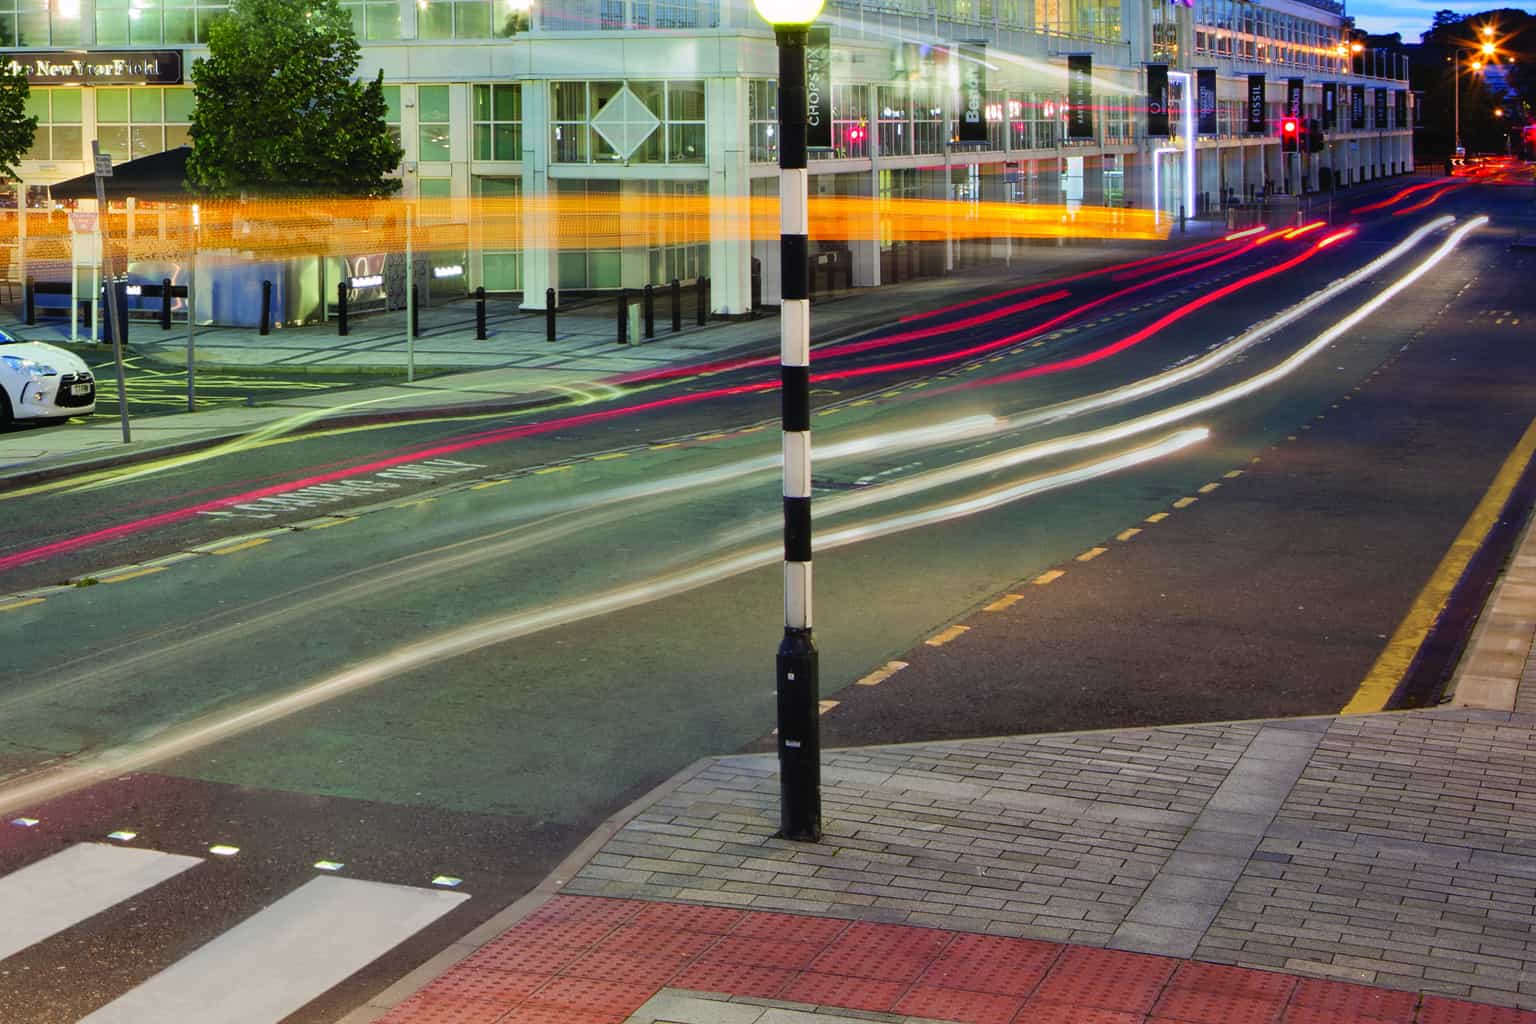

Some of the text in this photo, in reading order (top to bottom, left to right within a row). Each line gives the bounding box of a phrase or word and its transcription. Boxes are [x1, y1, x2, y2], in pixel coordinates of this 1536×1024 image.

[35, 59, 73, 77] New
[807, 48, 821, 127] CHOPSTIX
[1251, 84, 1262, 123] FOSSIL
[375, 457, 488, 480] ONLY
